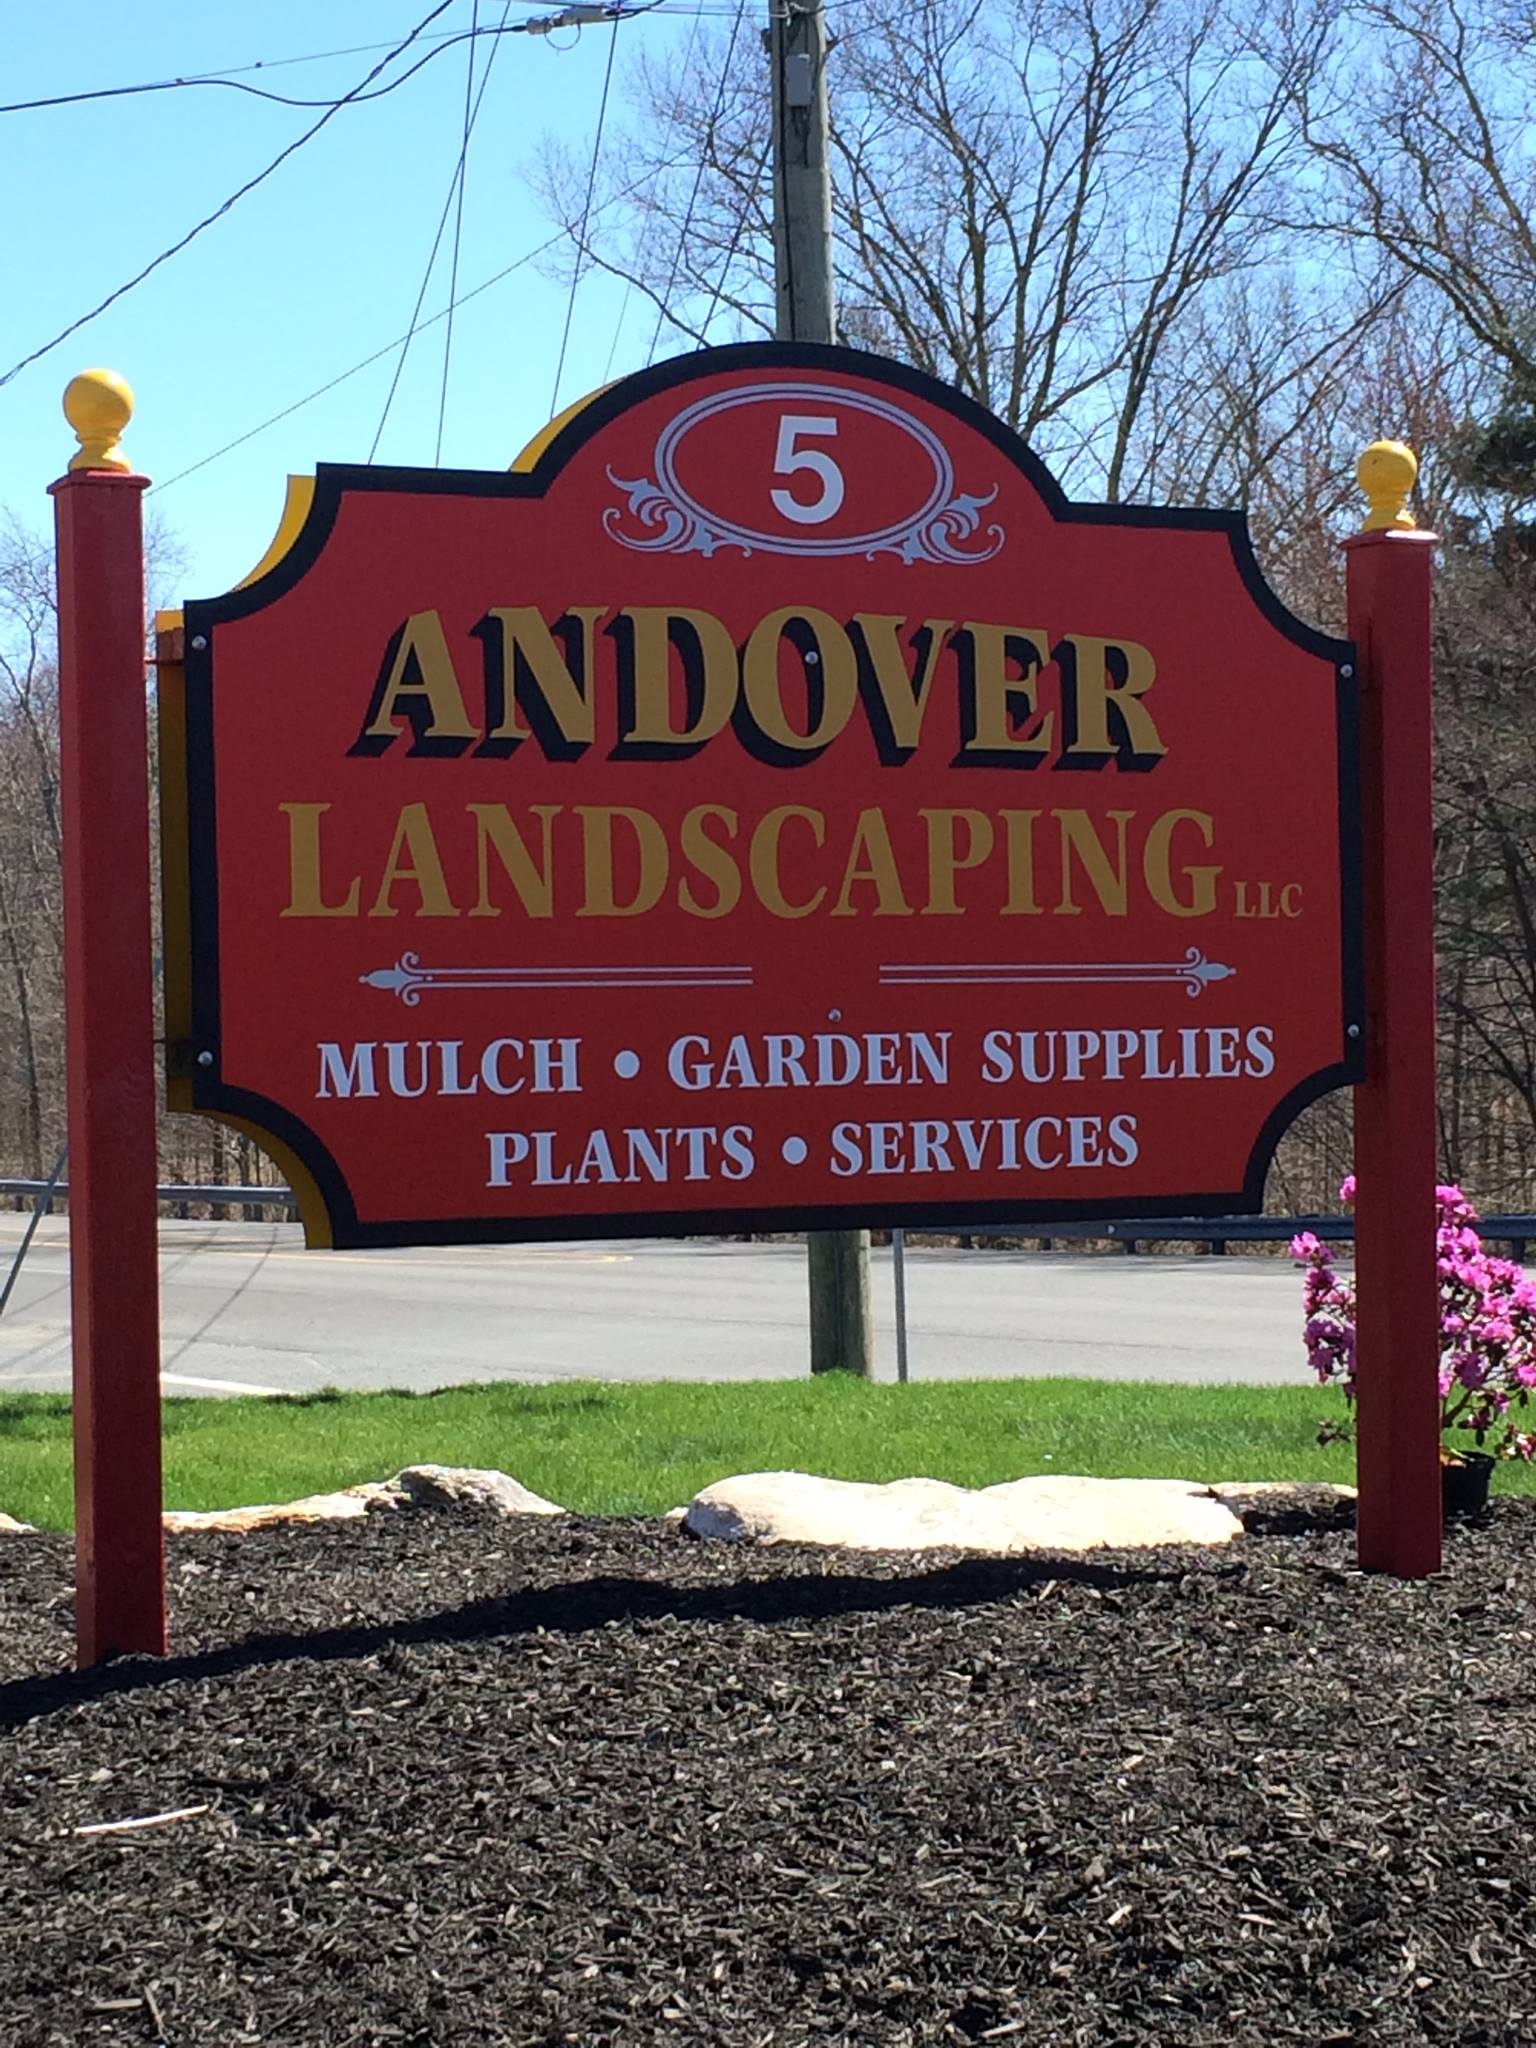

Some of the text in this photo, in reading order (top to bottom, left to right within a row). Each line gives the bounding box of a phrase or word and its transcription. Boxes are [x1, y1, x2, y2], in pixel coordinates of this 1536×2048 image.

[769, 414, 846, 526] 5
[348, 605, 1169, 772] ANDOVER
[278, 802, 1305, 920] LANDSCAPING LLC
[314, 1025, 1275, 1099] MULCH GARDEN SUPPLIES
[485, 1113, 1140, 1188] PLANTS SERVICES
